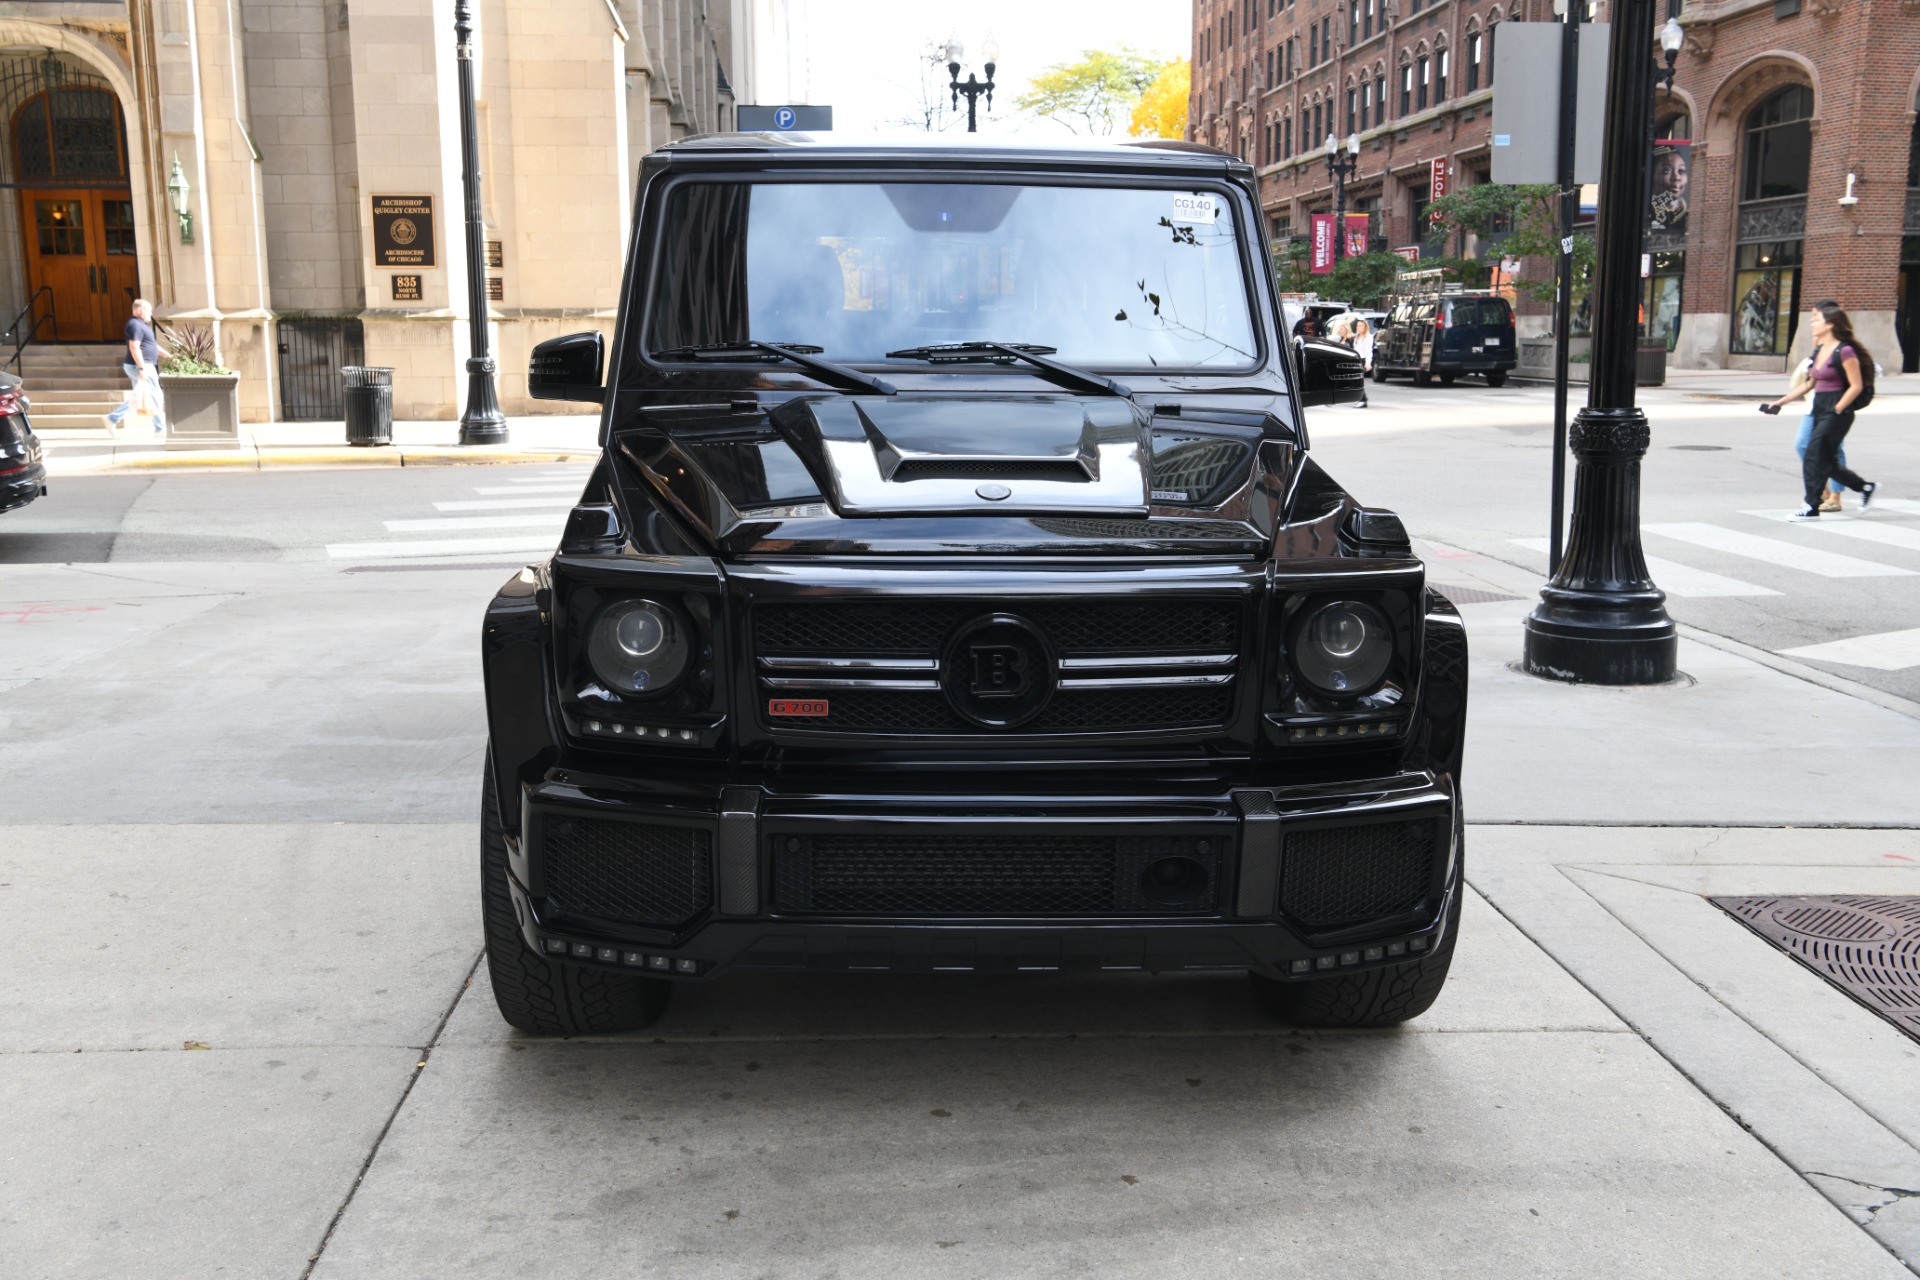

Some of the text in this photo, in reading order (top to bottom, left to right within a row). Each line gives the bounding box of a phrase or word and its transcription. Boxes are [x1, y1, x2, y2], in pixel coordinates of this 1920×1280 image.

[780, 110, 791, 126] P
[1433, 161, 1444, 219] CPOTLE
[1174, 198, 1211, 211] CG140
[1315, 220, 1326, 268] WELCOME
[396, 276, 417, 288] 835
[970, 645, 1030, 697] B
[773, 703, 825, 713] G 700
